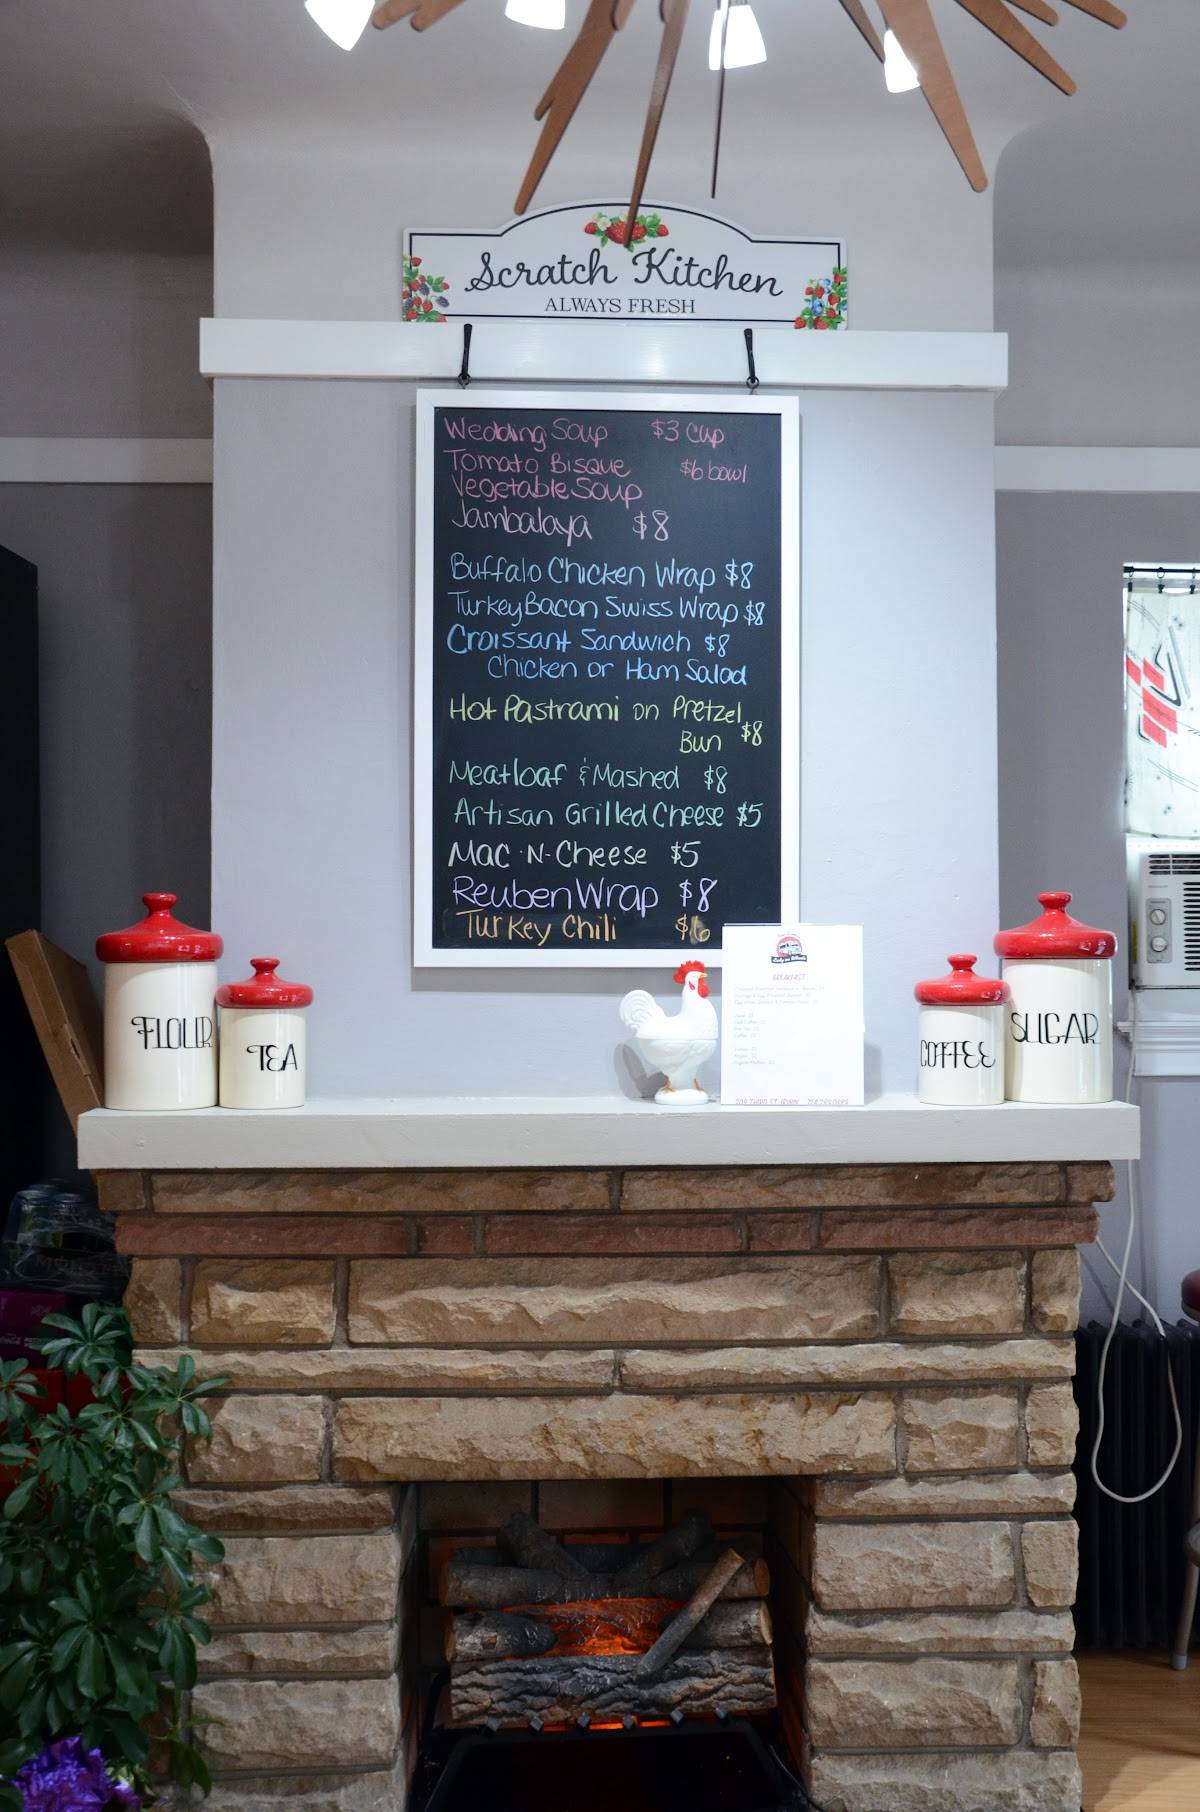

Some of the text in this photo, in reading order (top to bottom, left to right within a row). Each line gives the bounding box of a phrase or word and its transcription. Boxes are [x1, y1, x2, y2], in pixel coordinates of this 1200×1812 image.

[464, 246, 784, 297] Scratch Kitchen
[545, 297, 695, 315] ALWAYS FRESH
[444, 417, 724, 452] Wedding Soup $3 Cup
[443, 448, 538, 474] Tomato
[680, 459, 703, 480] $6
[708, 461, 747, 483] bowl
[451, 474, 642, 509] Vegetable Soup
[452, 500, 592, 547] Jambalaya
[450, 552, 754, 594] Buffalo Chicken Wrap $8
[447, 590, 766, 627] Turkey Bacon Swiss Wrap $8
[447, 623, 730, 657] Croissant Sandwich $8
[487, 655, 747, 686] Chicken or Ham Salad
[450, 692, 741, 724] Hot Pastrami on Pretzel
[679, 720, 763, 754] Bun $8
[450, 758, 567, 789] Meatloaf
[593, 763, 680, 790] Mashed
[704, 764, 728, 794] $8
[454, 797, 764, 828] Artisan Grilled Cheese $5
[556, 840, 647, 868] Cheese
[671, 841, 701, 868] $5
[452, 875, 571, 910] Reuben
[575, 877, 659, 918] Wrap
[562, 913, 617, 942] Chili
[131, 1016, 214, 1050] FLOUR
[1010, 1012, 1101, 1045] SUGAR
[246, 1043, 298, 1072] TEA
[920, 1039, 996, 1069] COFFEE
